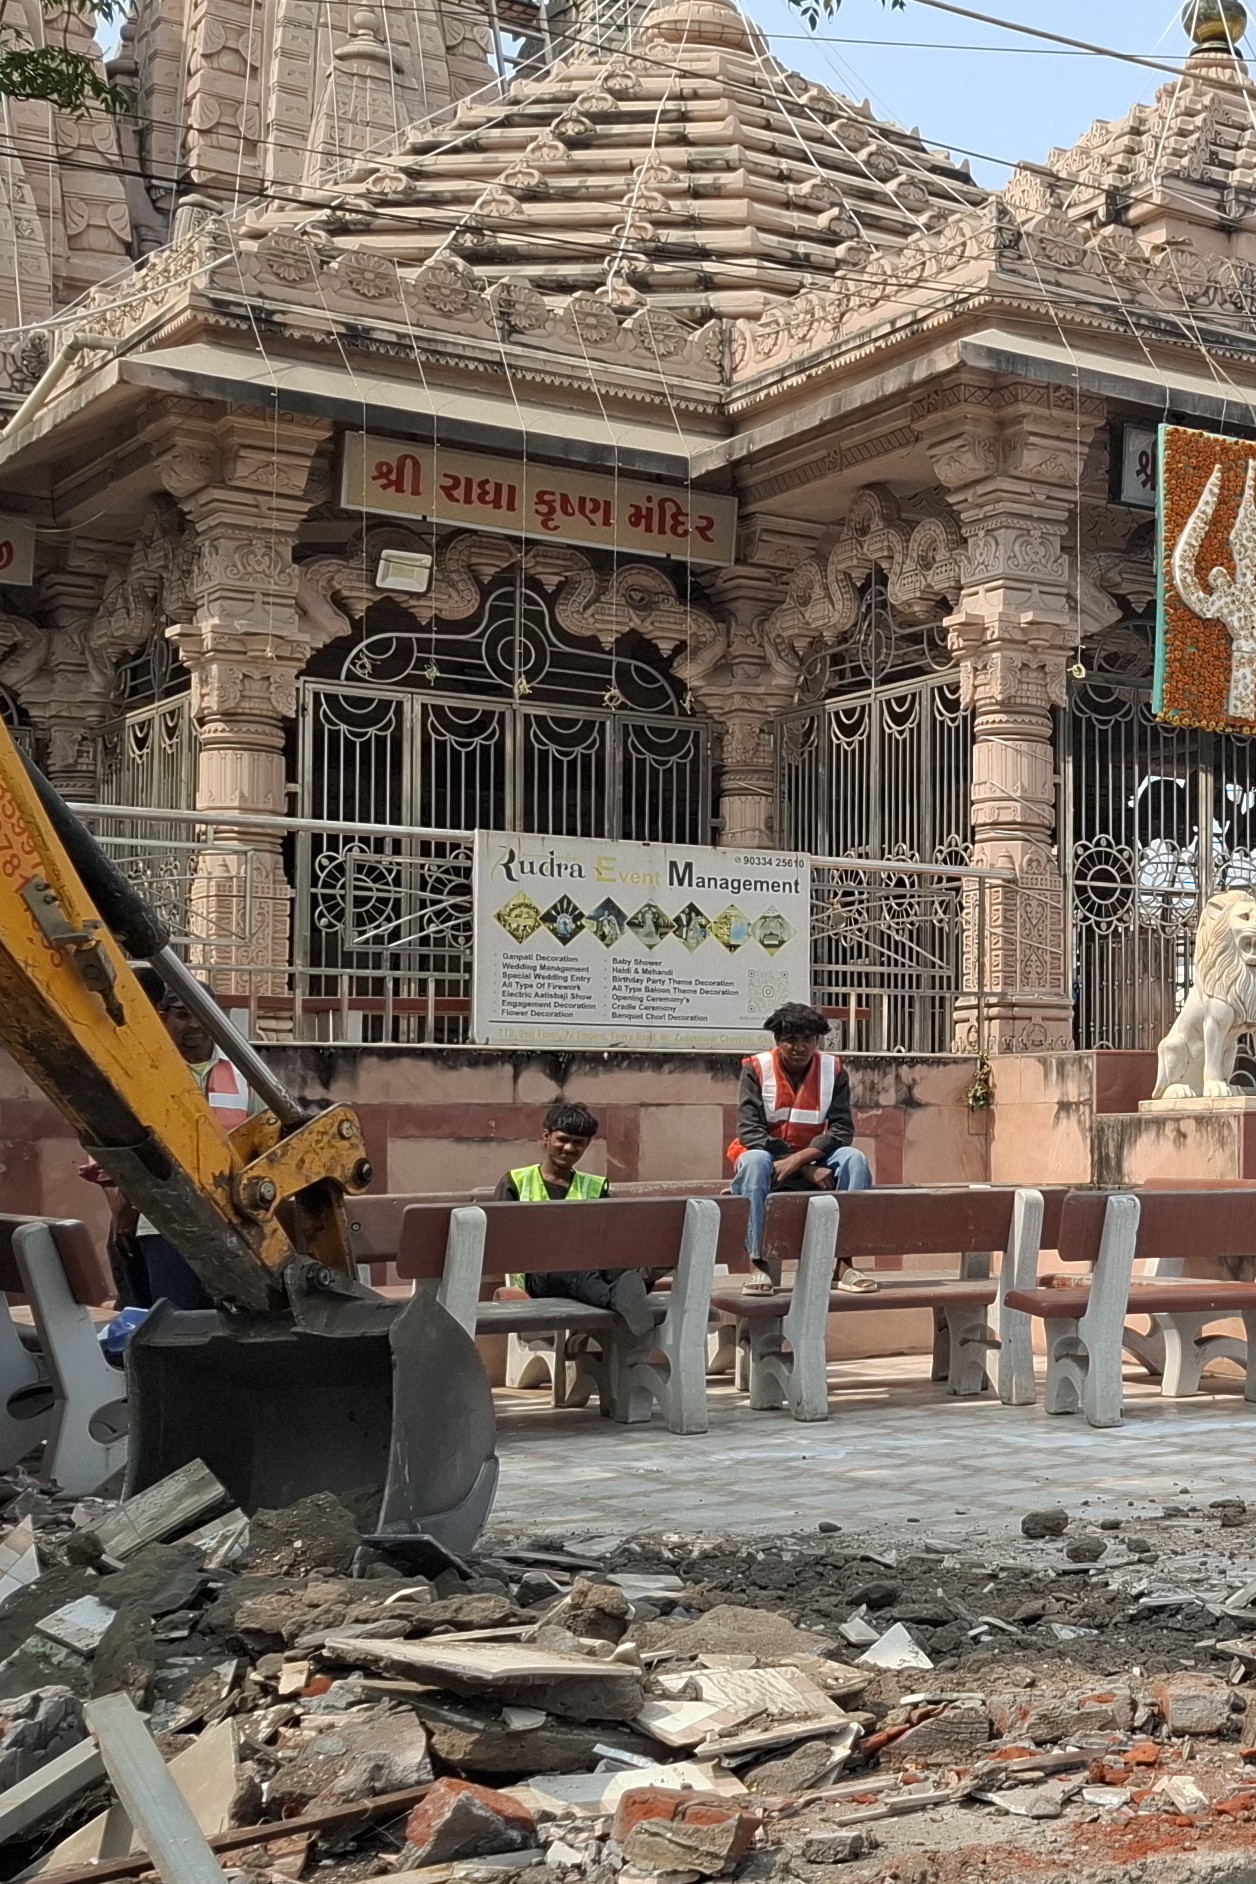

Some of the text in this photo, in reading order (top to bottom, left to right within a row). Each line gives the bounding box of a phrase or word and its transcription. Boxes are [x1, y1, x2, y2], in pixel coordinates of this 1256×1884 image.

[371, 453, 715, 544] શ્રી રાધા કૃષ્ણ મંદિર
[743, 855, 772, 867] 90334
[491, 846, 800, 895] Rudra Event Management
[536, 954, 578, 963] Decoration
[634, 958, 662, 967] Shower
[502, 962, 590, 974] Wedding Management
[502, 971, 592, 983] Special Wedding Entry
[612, 976, 734, 987] Birthday Party Theme Decoration
[515, 981, 534, 990] Type
[536, 982, 546, 990] Of
[547, 983, 582, 991] Firework
[625, 985, 642, 994] Type
[673, 987, 697, 995] Theme
[699, 988, 739, 996] Decoration
[502, 990, 532, 999] Electric
[612, 994, 644, 1003] Opening
[501, 1000, 597, 1010] Engagement Decoration
[638, 1003, 677, 1013] Ceremony
[501, 1009, 574, 1018] Flower Decoration
[612, 1012, 643, 1021] Banquet
[668, 1013, 708, 1022] Decoration
